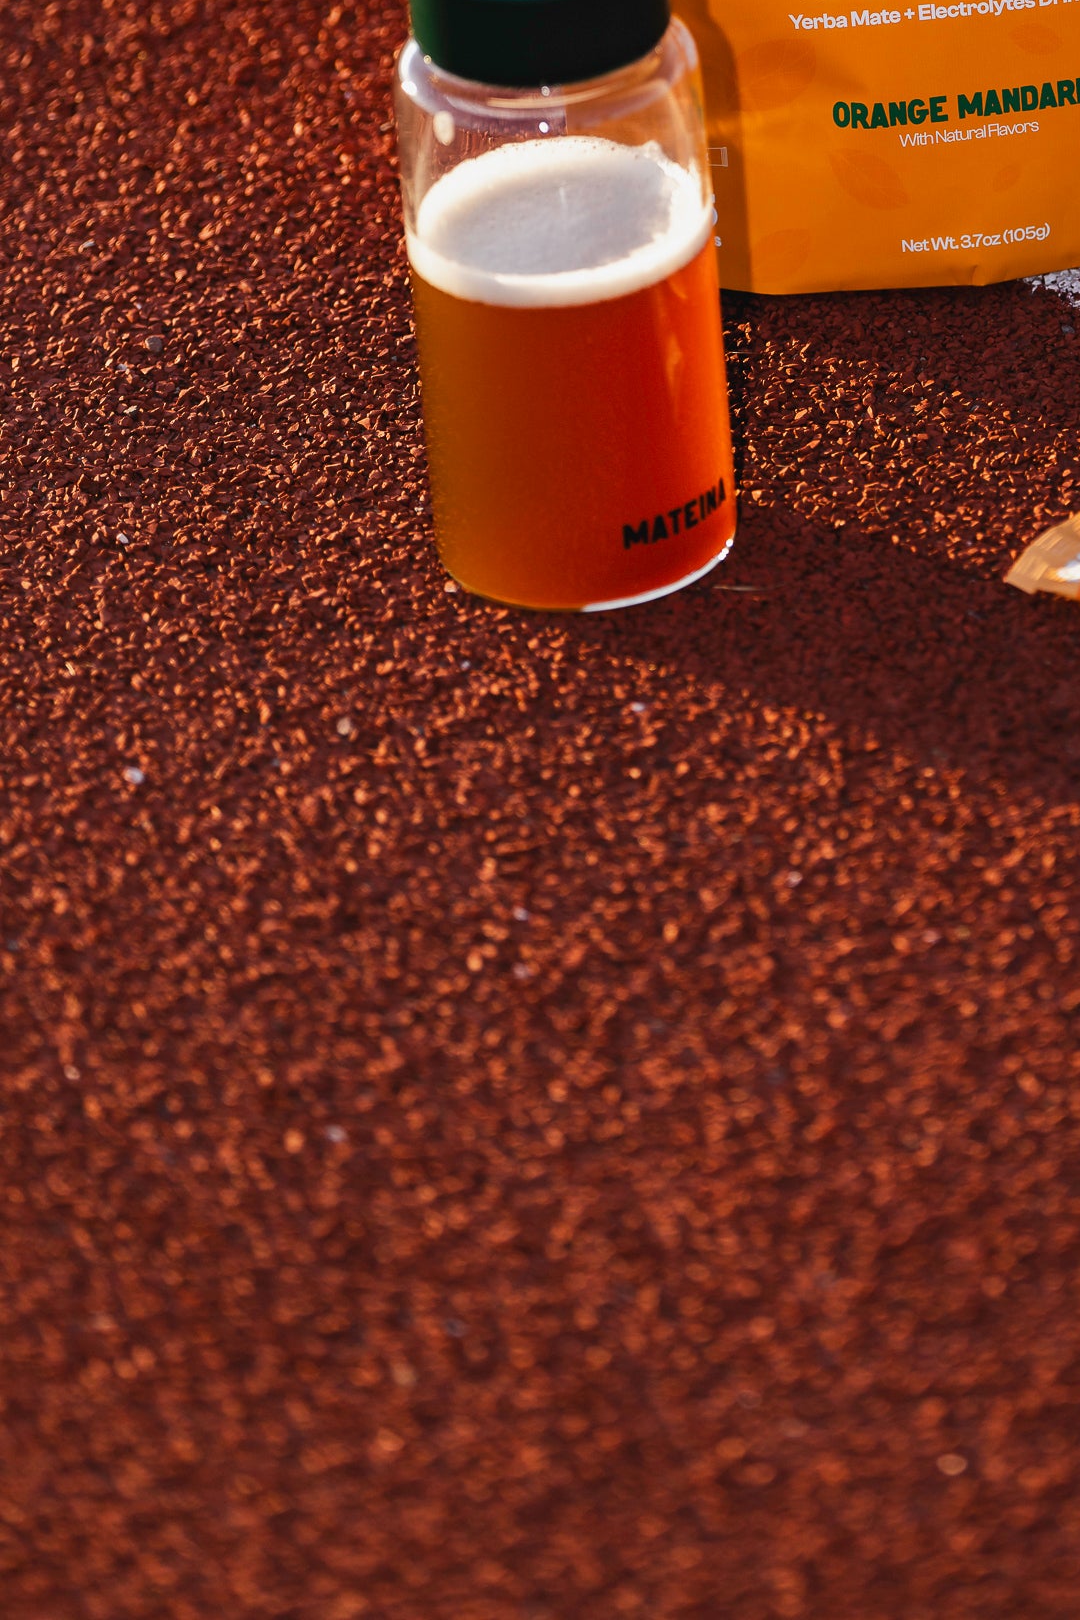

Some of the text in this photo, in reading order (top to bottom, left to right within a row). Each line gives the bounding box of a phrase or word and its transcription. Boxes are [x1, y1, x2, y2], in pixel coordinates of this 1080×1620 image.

[788, 13, 848, 31] Yerba
[850, 9, 901, 27] Mate
[904, 8, 916, 21] +
[832, 95, 949, 130] ORANGE
[899, 120, 1040, 148] With Natural Flavors
[901, 222, 1051, 253] Net Wt. 3.7oz (105g)
